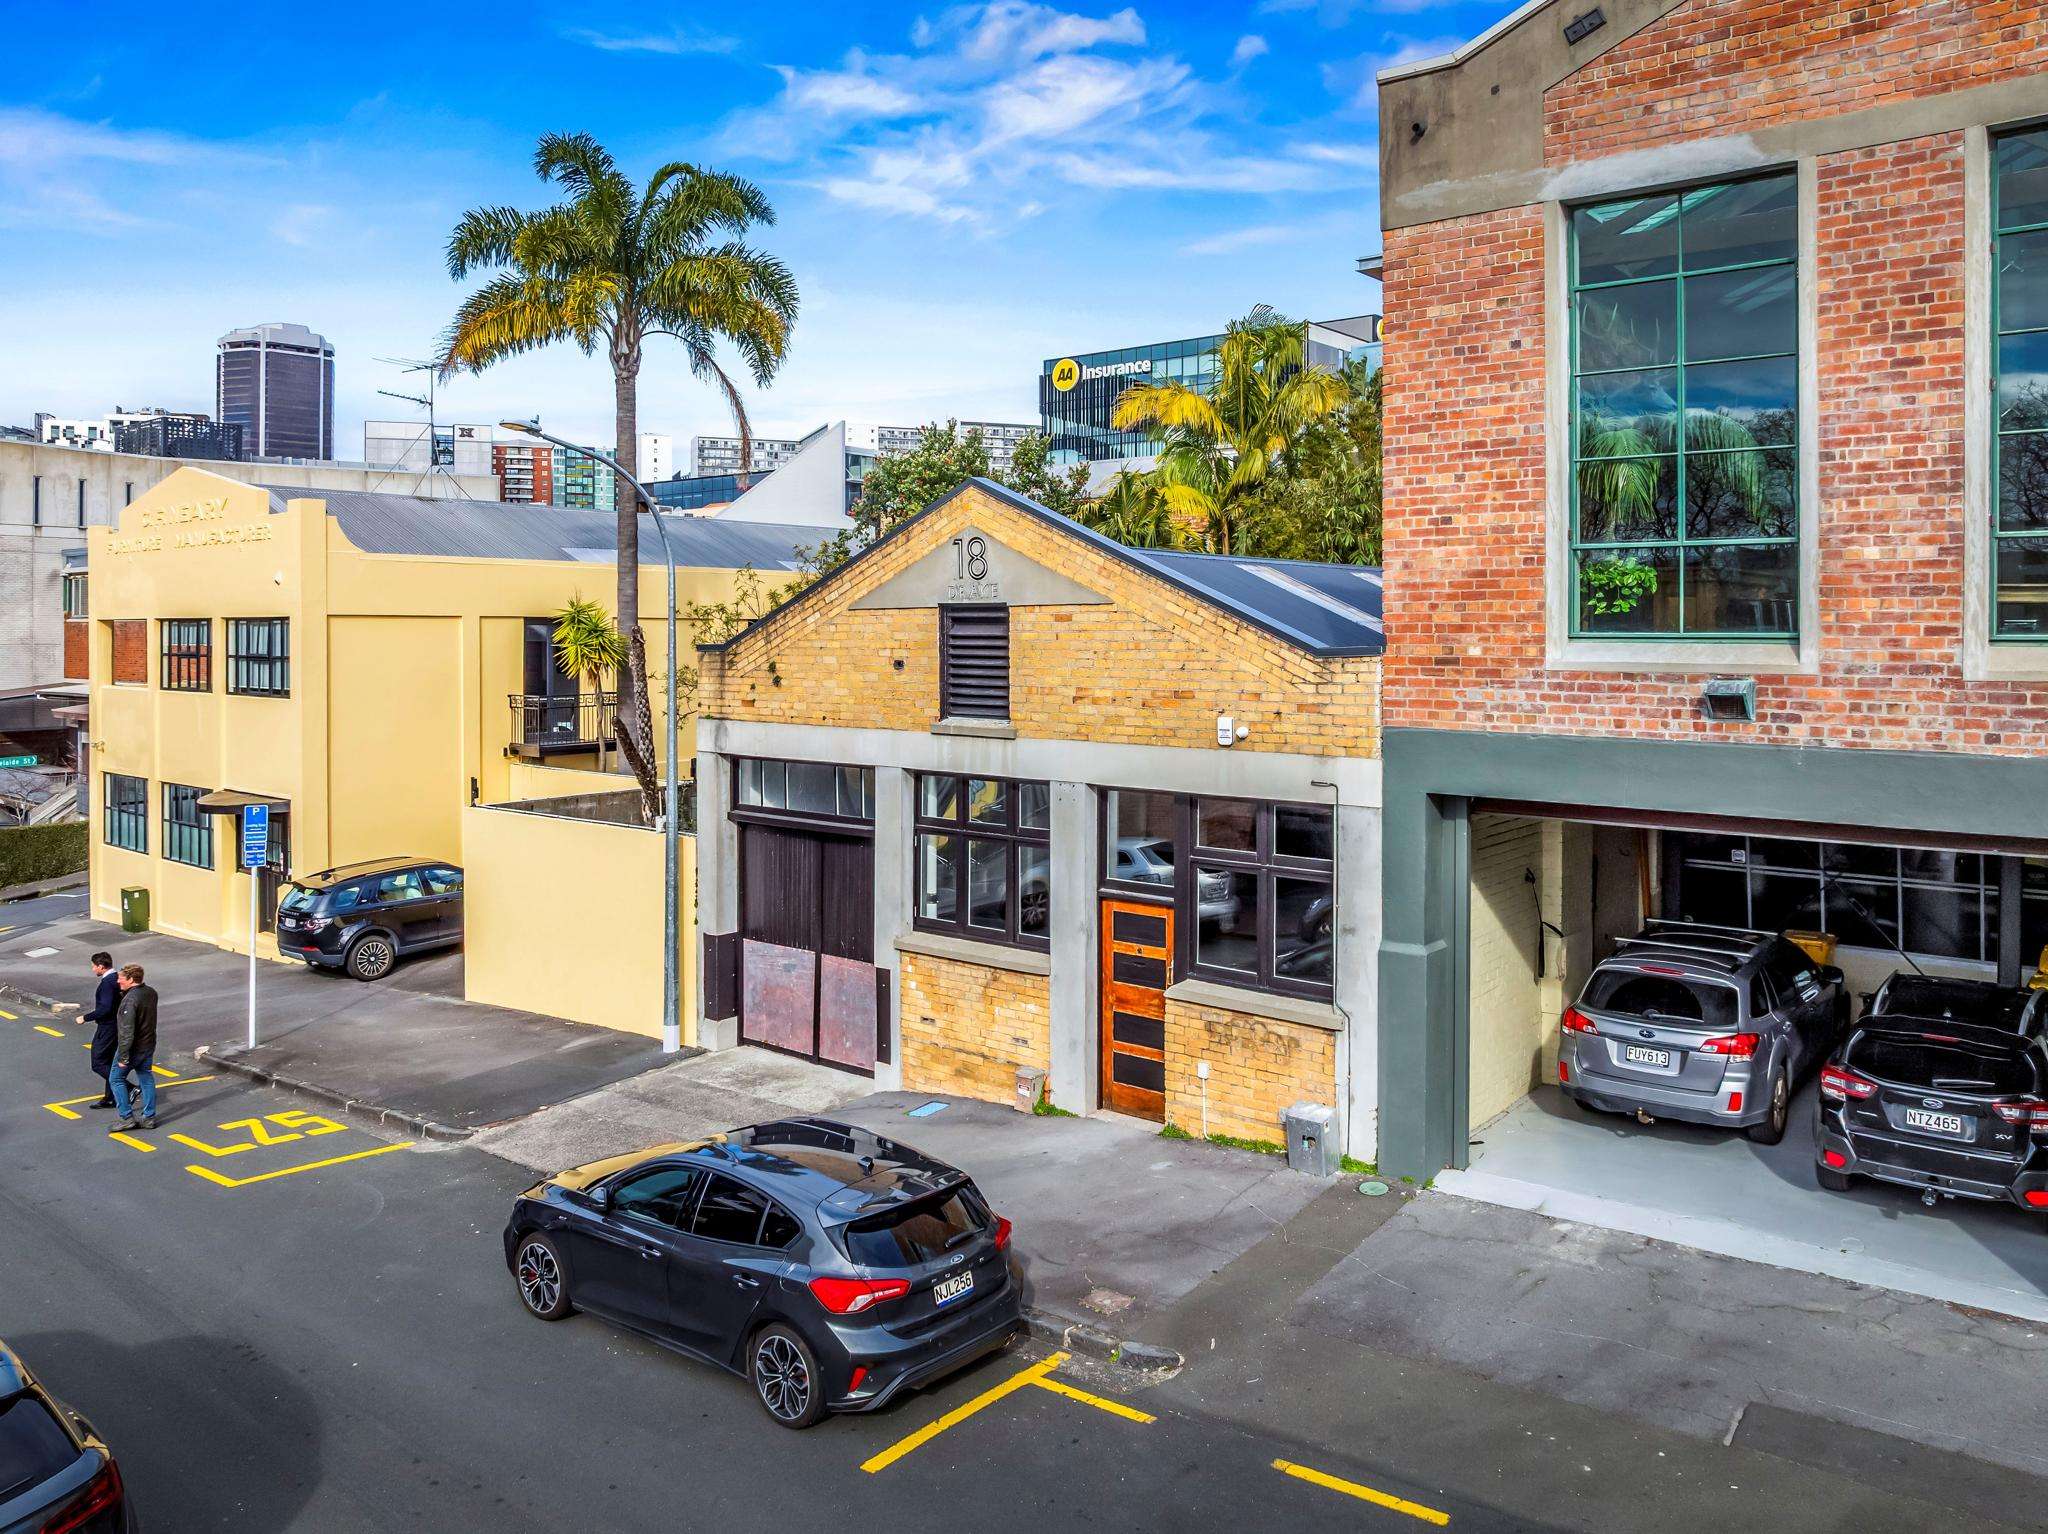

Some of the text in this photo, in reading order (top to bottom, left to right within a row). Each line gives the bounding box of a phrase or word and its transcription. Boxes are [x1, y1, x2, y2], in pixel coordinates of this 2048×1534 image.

[1056, 360, 1152, 383] AA Insurance
[952, 536, 988, 580] 18
[252, 807, 260, 816] P
[1628, 1047, 1667, 1064] FUY613
[1908, 1110, 1959, 1131] NTZ465
[935, 1272, 972, 1303] NJL256
